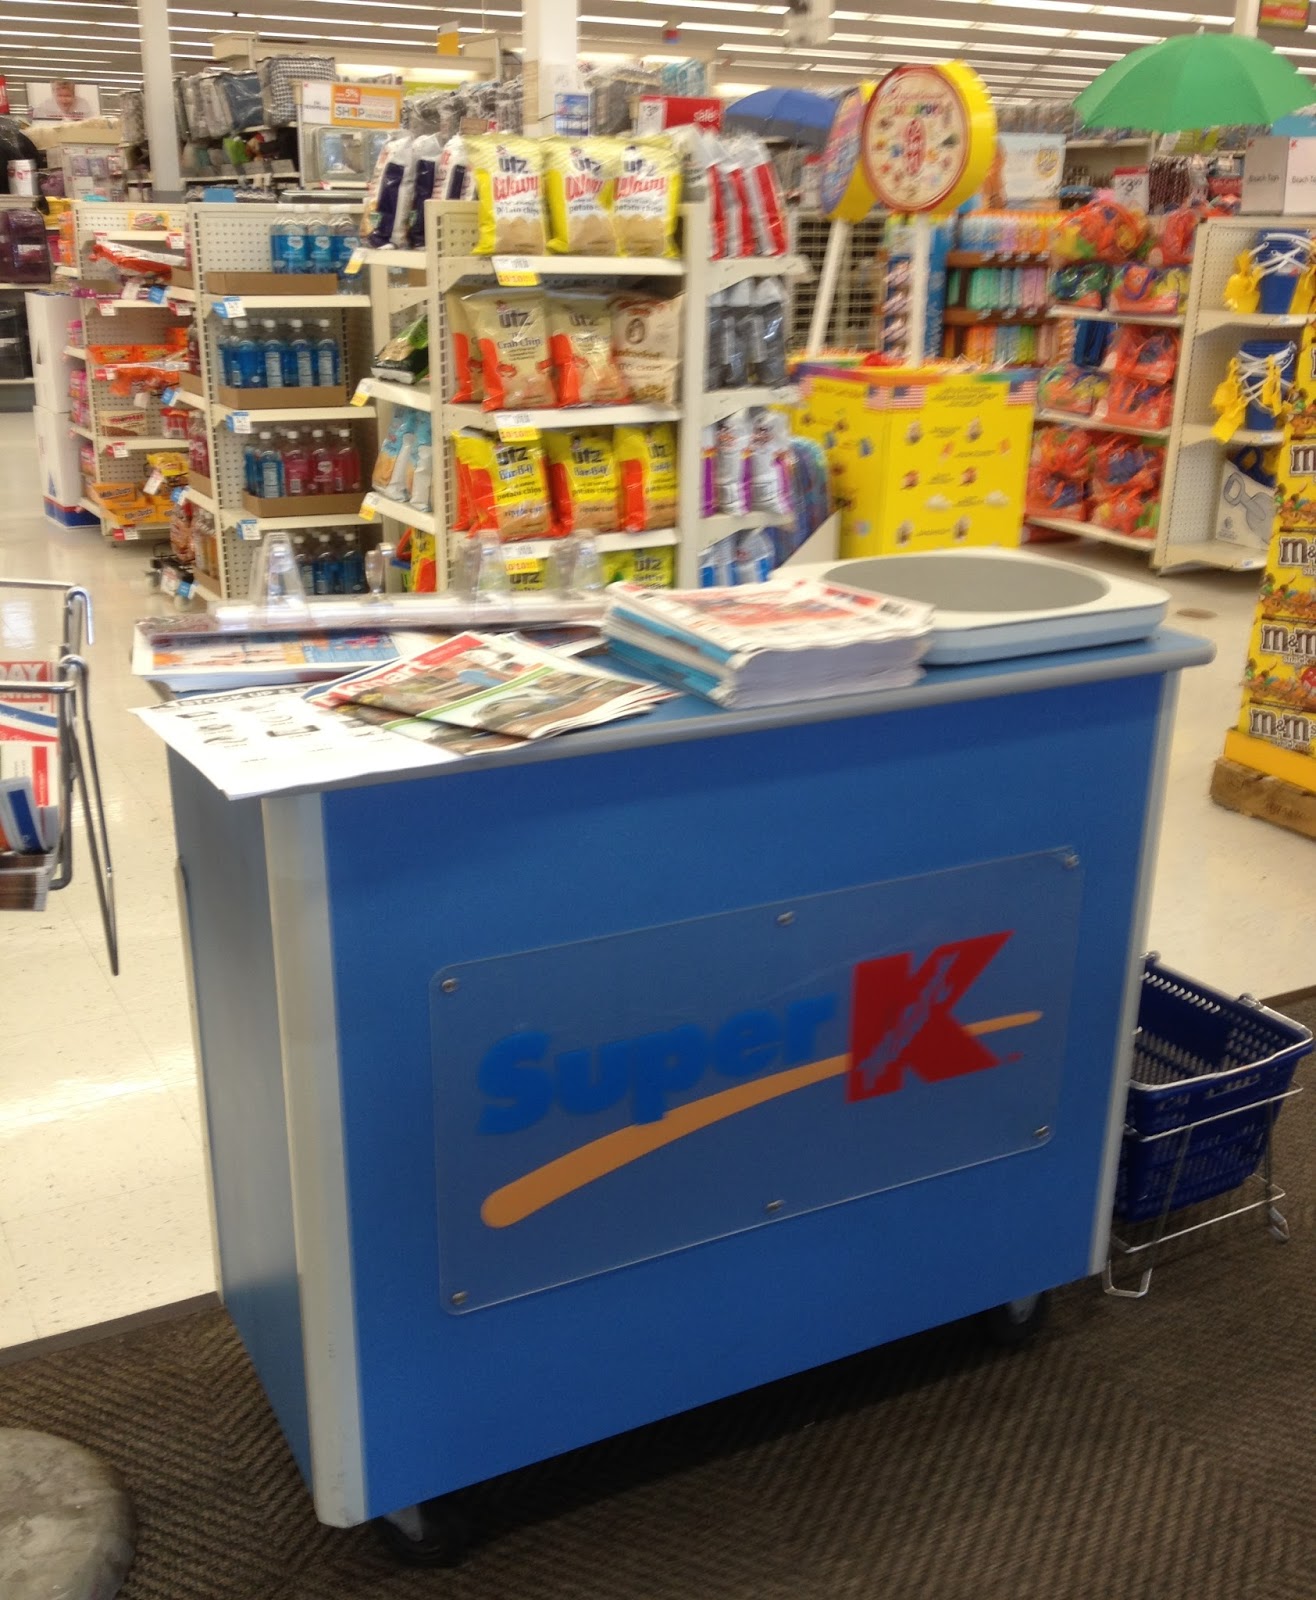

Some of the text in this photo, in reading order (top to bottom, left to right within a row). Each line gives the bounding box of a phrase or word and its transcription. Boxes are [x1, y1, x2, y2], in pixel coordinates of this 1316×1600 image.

[498, 156, 528, 174] utz
[499, 310, 532, 329] utz
[476, 929, 1016, 1136] Super K
